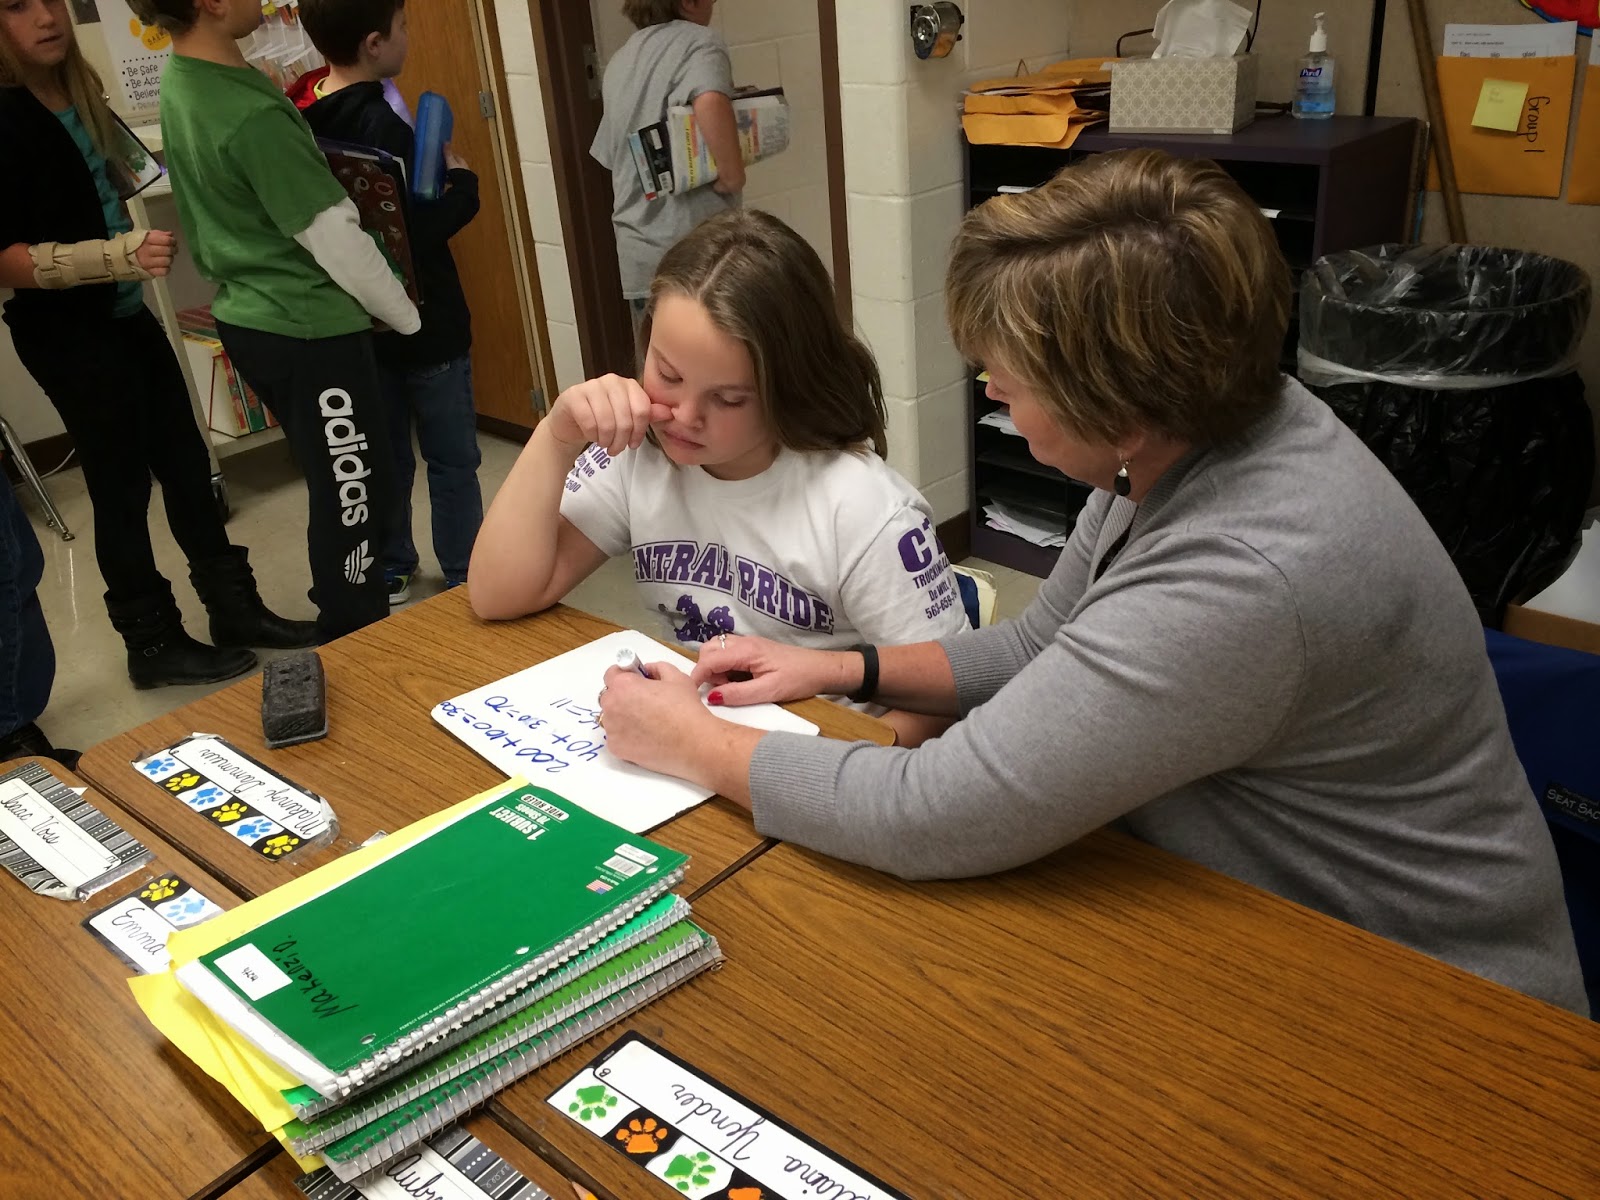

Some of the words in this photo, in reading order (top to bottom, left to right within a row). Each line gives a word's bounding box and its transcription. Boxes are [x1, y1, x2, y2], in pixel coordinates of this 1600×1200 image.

[127, 67, 138, 77] Be
[140, 64, 158, 76] Safe
[130, 79, 141, 89] Be
[144, 76, 160, 86] Acc
[1517, 96, 1551, 142] Group
[318, 387, 372, 527] adidas
[591, 447, 611, 469] Inc
[736, 555, 834, 635] PRIDE
[928, 589, 938, 601] De
[523, 795, 545, 812] RULED
[543, 805, 565, 819] WIDE
[1547, 789, 1576, 808] SEAT
[1578, 802, 1600, 820] SAC
[488, 807, 538, 834] SUBJECT
[526, 828, 546, 841] 1
[111, 907, 166, 955] Emma
